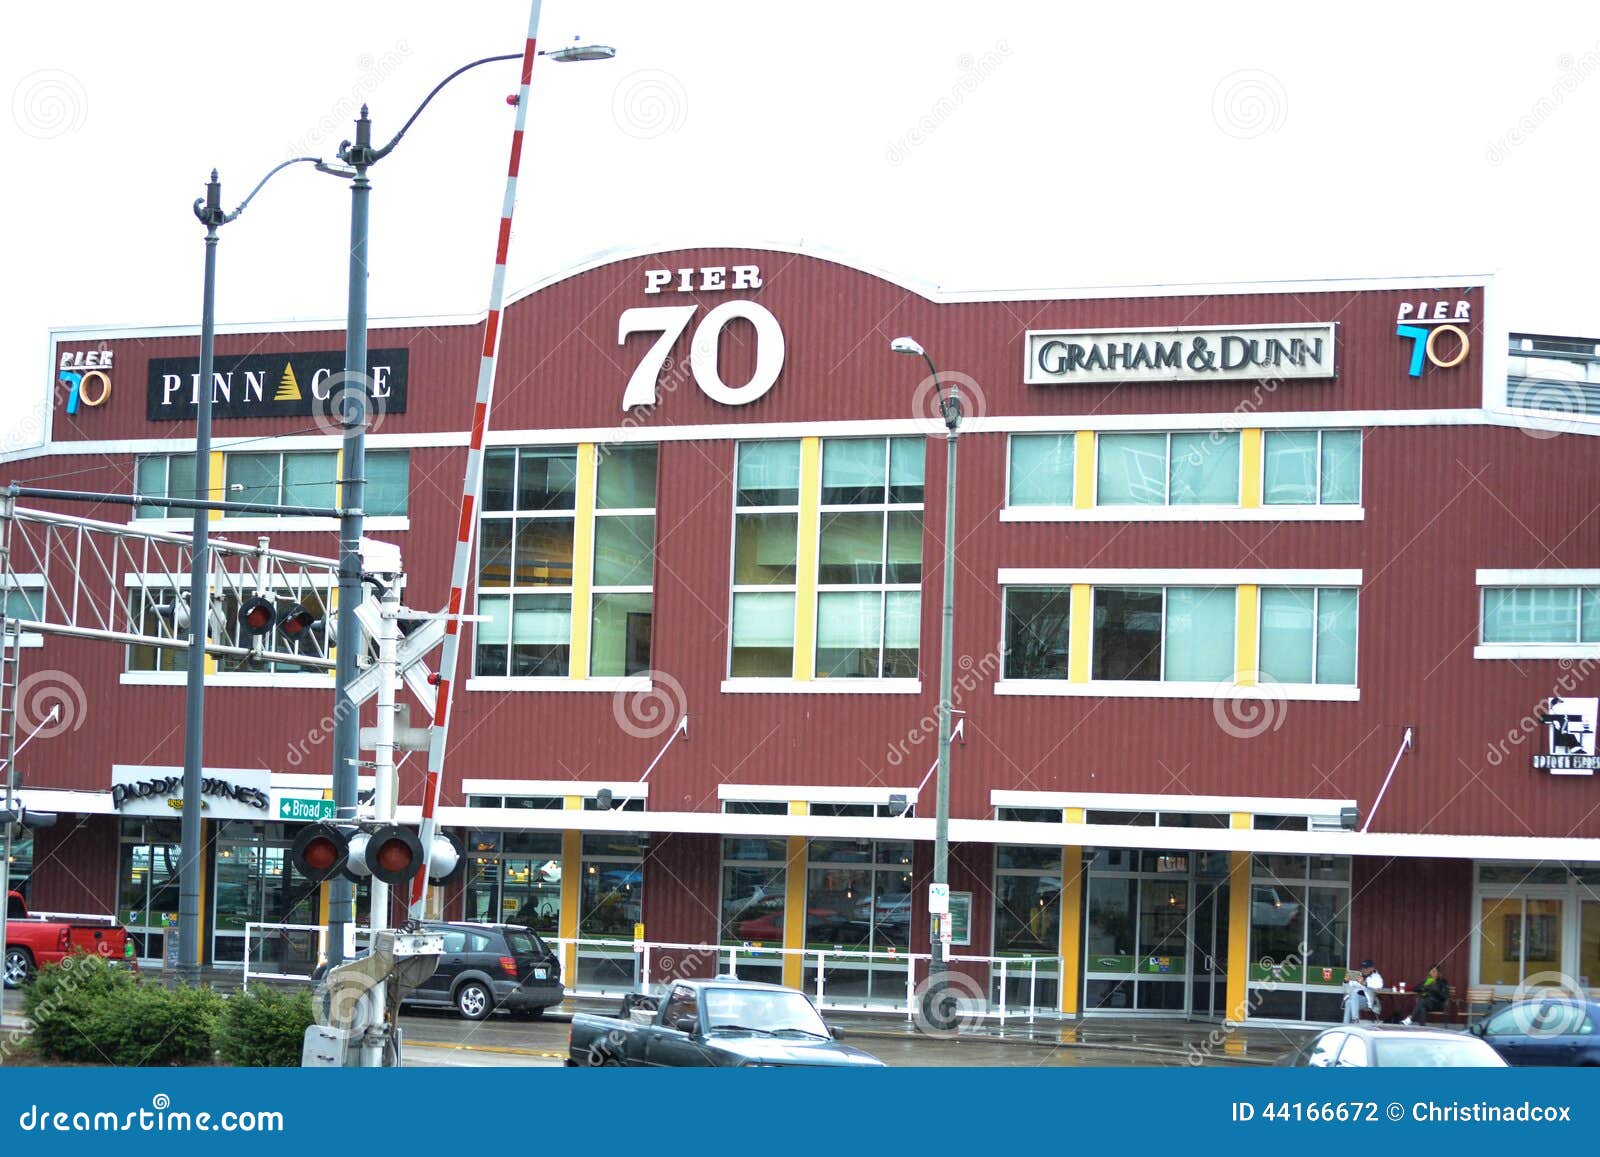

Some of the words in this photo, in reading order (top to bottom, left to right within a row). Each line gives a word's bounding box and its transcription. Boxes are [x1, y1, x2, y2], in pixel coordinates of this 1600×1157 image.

[644, 265, 763, 294] PIER
[1397, 301, 1471, 320] PIER
[60, 351, 114, 368] PIER
[618, 300, 785, 412] 70
[1396, 324, 1470, 377] 70
[59, 370, 112, 414] 70
[162, 362, 391, 405] PINNACE
[293, 800, 320, 818] Broad
